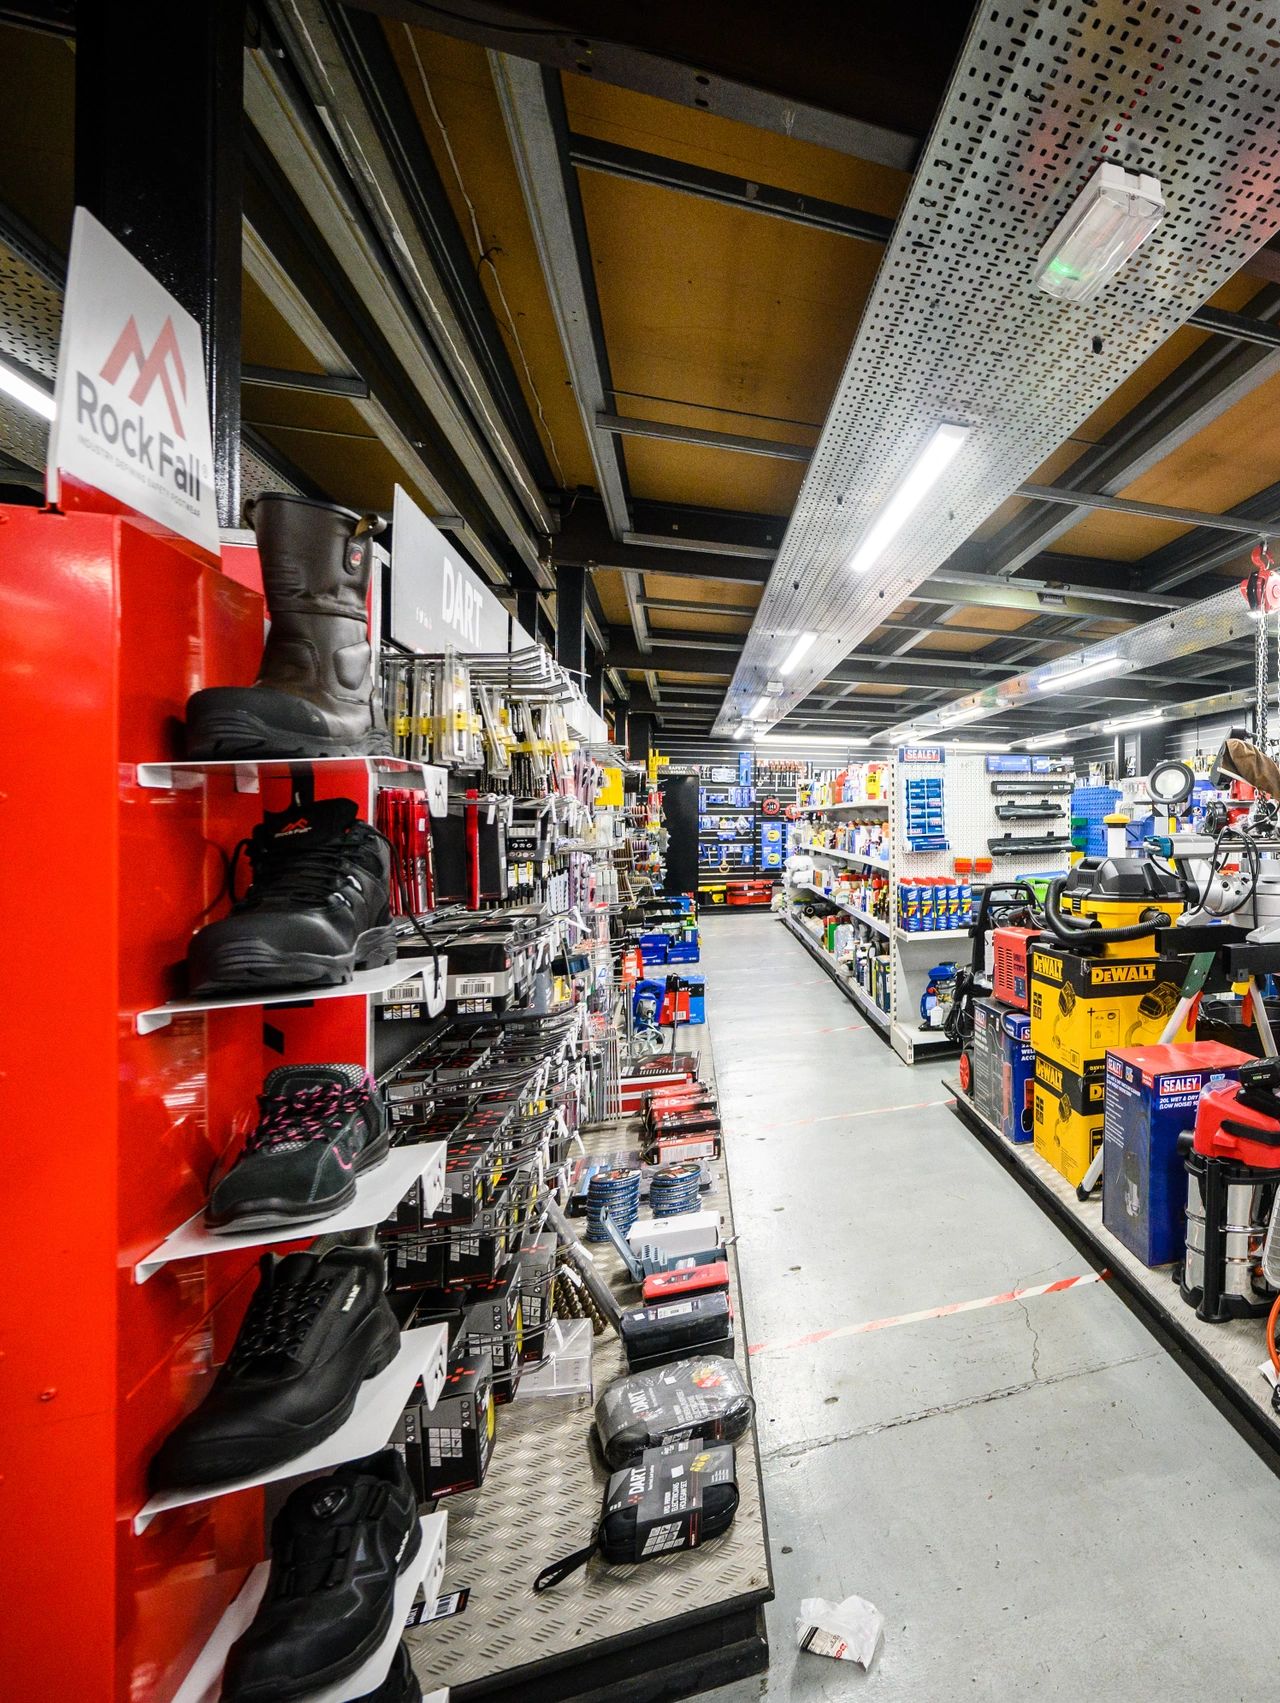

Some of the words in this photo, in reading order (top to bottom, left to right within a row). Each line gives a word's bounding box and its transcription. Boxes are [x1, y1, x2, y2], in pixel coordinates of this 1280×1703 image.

[442, 556, 482, 649] DART
[907, 749, 937, 759] SEALEY
[1164, 1077, 1198, 1093] SEALEY
[628, 1389, 649, 1413] DART
[629, 1466, 646, 1495] DART
